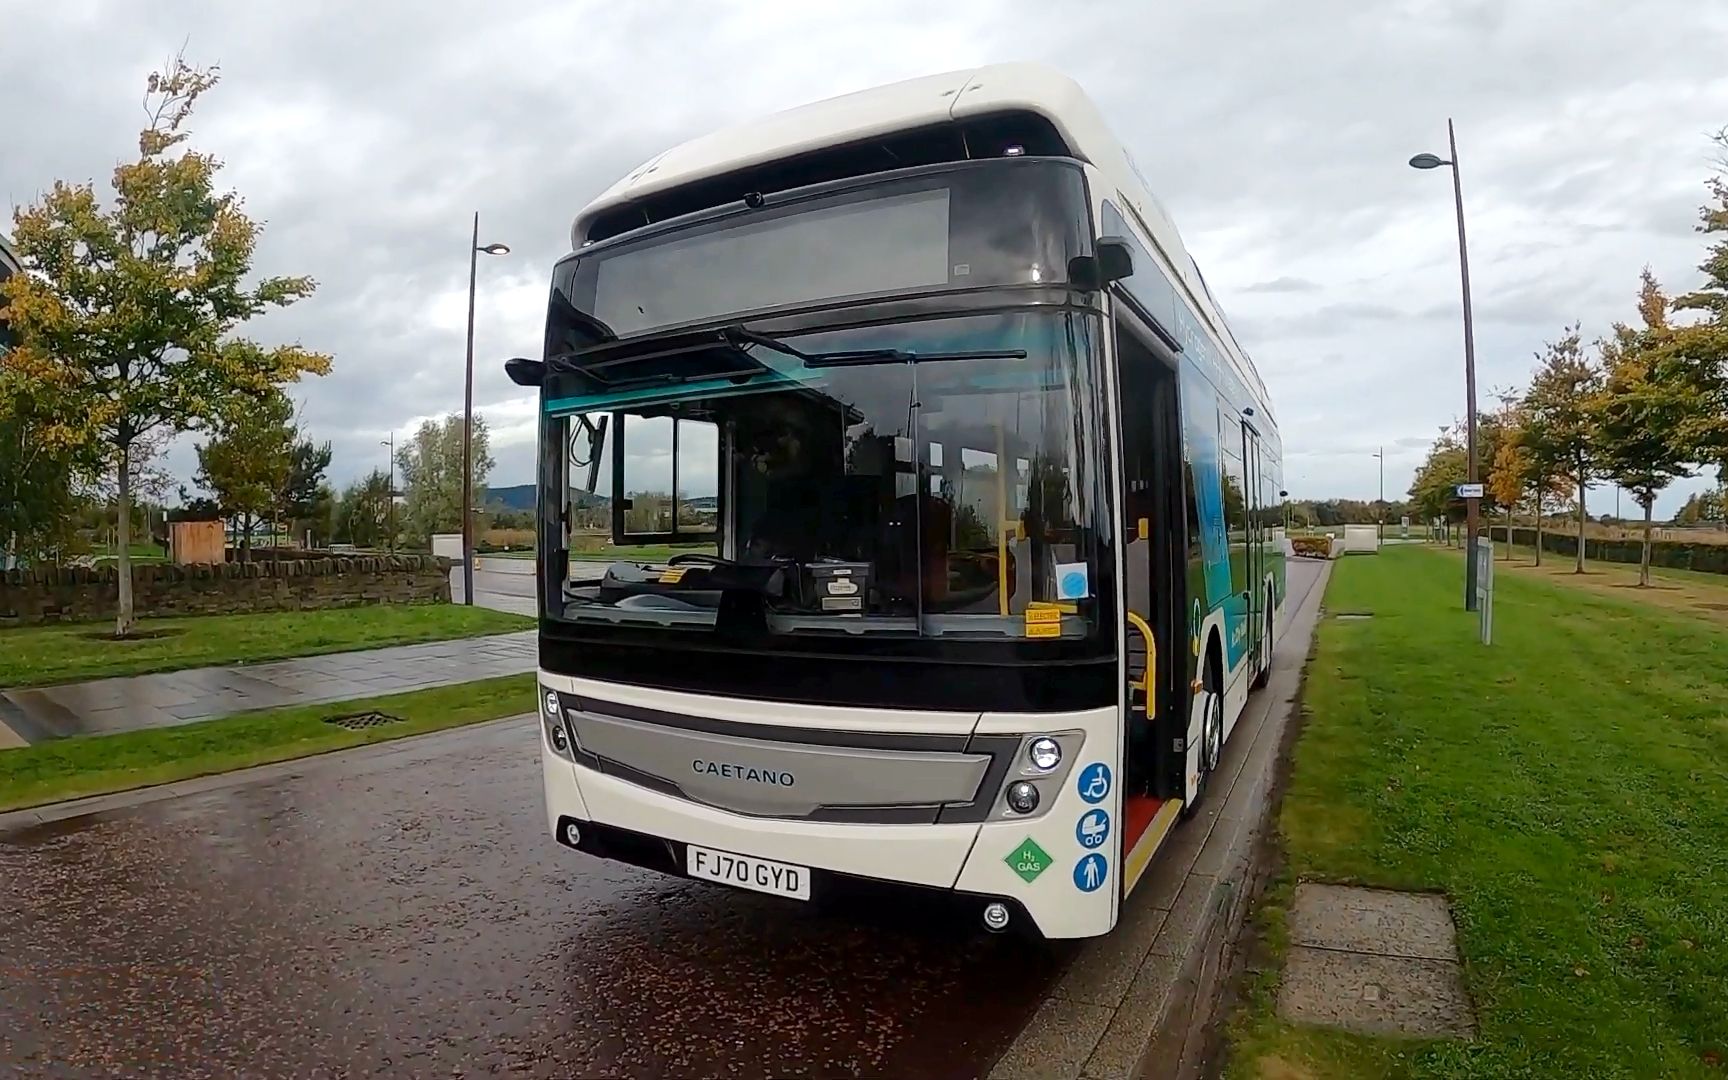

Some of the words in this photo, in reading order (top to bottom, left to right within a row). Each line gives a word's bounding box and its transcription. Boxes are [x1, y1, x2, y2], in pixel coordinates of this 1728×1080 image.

[692, 759, 795, 787] CAETANO
[696, 851, 748, 881] FJ70
[756, 864, 799, 892] GYD
[1017, 862, 1040, 872] GAS
